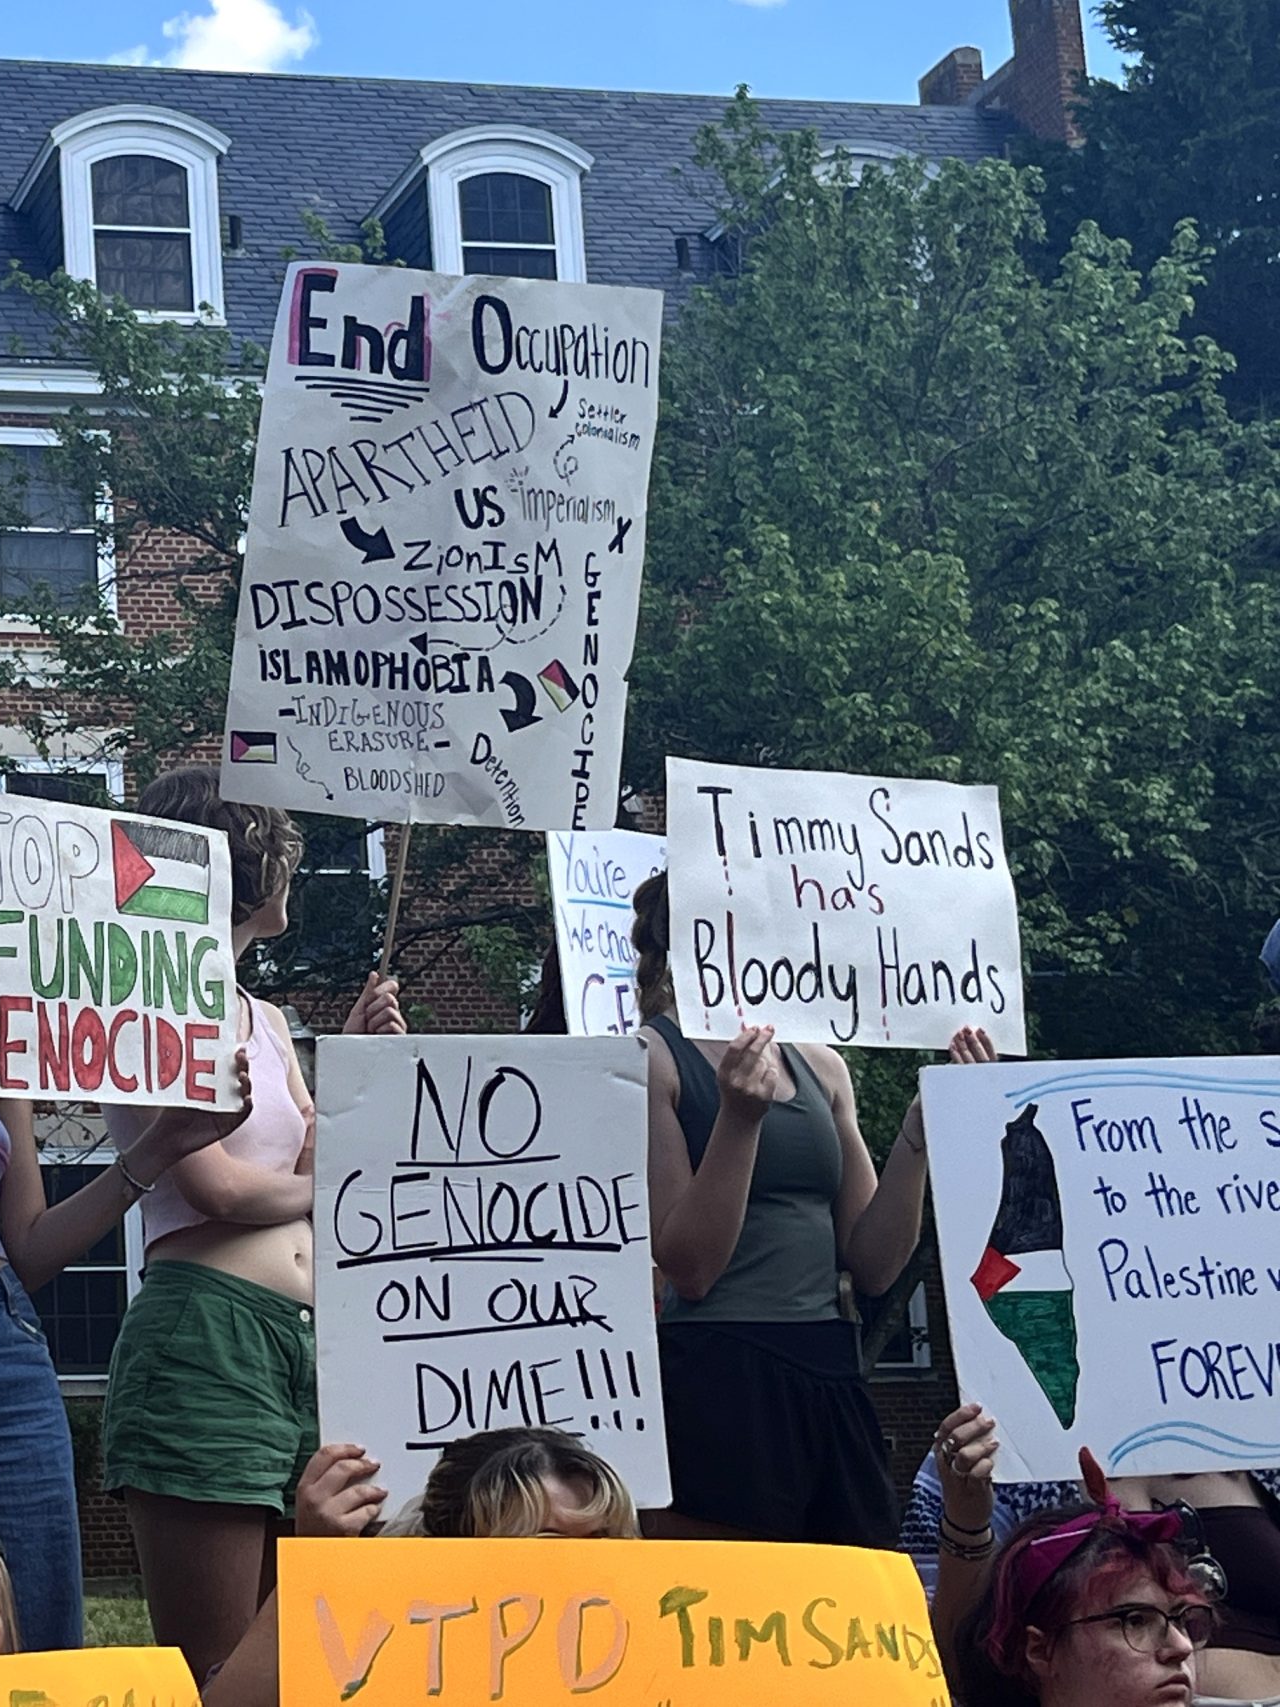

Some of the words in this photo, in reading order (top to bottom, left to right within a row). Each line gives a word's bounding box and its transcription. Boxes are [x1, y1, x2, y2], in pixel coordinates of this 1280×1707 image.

[287, 267, 432, 383] End
[471, 294, 650, 388] Occupation
[575, 421, 641, 451] colonialism
[577, 397, 628, 425] Settler
[278, 391, 535, 528] APARTHEID
[454, 484, 507, 530] US
[250, 574, 544, 632] DISPOSSESSION
[570, 551, 603, 832] GENOCIDE
[343, 766, 446, 798] BLOODSHED
[470, 732, 526, 829] Detention
[697, 786, 865, 892] Timmy
[868, 787, 995, 870] Sands
[790, 863, 884, 916] has
[693, 910, 859, 1042] Bloody
[876, 925, 1006, 1016] Hands
[410, 1056, 542, 1162] NO
[1070, 1097, 1163, 1154] From
[1178, 1096, 1239, 1154] the
[333, 1168, 649, 1257] GENOCIDE
[1093, 1175, 1128, 1217] to
[1144, 1172, 1201, 1219] the
[1097, 1237, 1259, 1302] Palestine
[375, 1273, 451, 1323] ON
[487, 1274, 614, 1333] OUR
[415, 1348, 646, 1434] DIME!!!
[1150, 1337, 1280, 1405] FOREV
